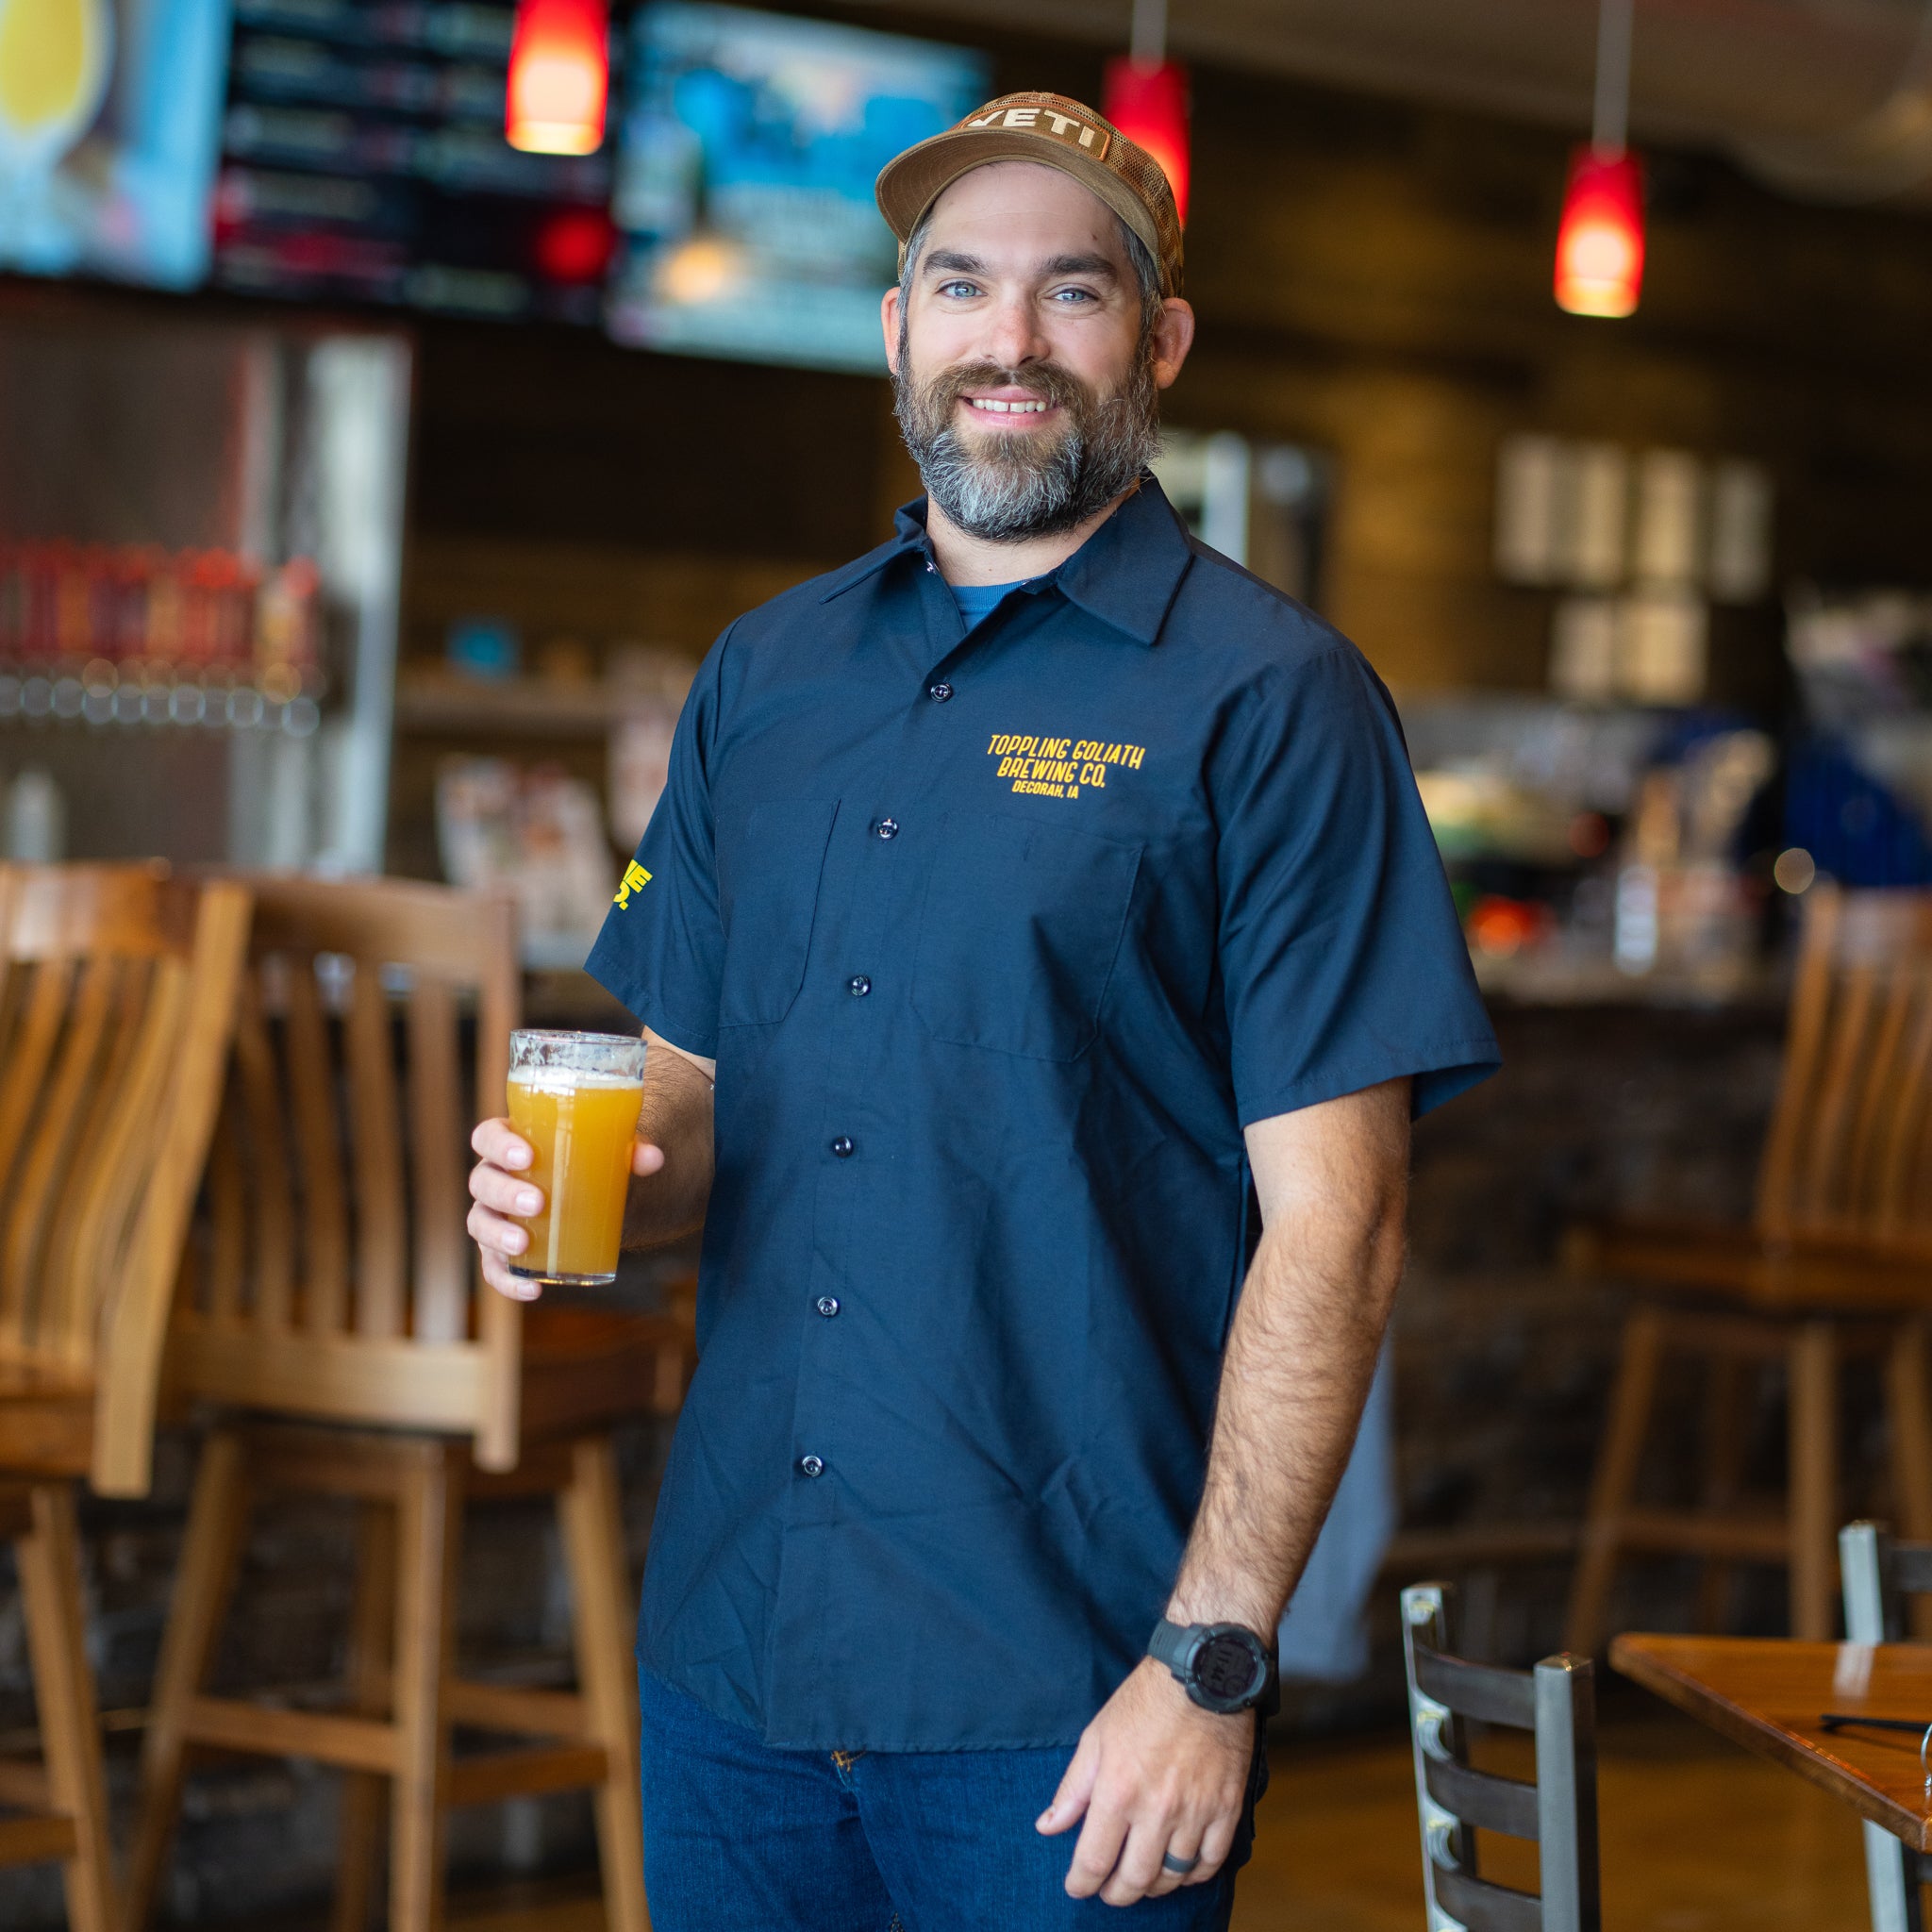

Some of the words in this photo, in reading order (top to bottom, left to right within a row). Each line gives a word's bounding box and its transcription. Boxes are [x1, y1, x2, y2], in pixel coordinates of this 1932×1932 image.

[987, 734, 1072, 759] TOPPLING
[1072, 740, 1146, 770] GOLIATH
[996, 757, 1078, 783] BREWING
[1079, 762, 1107, 788] CO.
[1011, 779, 1064, 799] DECORAH,
[1066, 785, 1079, 799] IA
